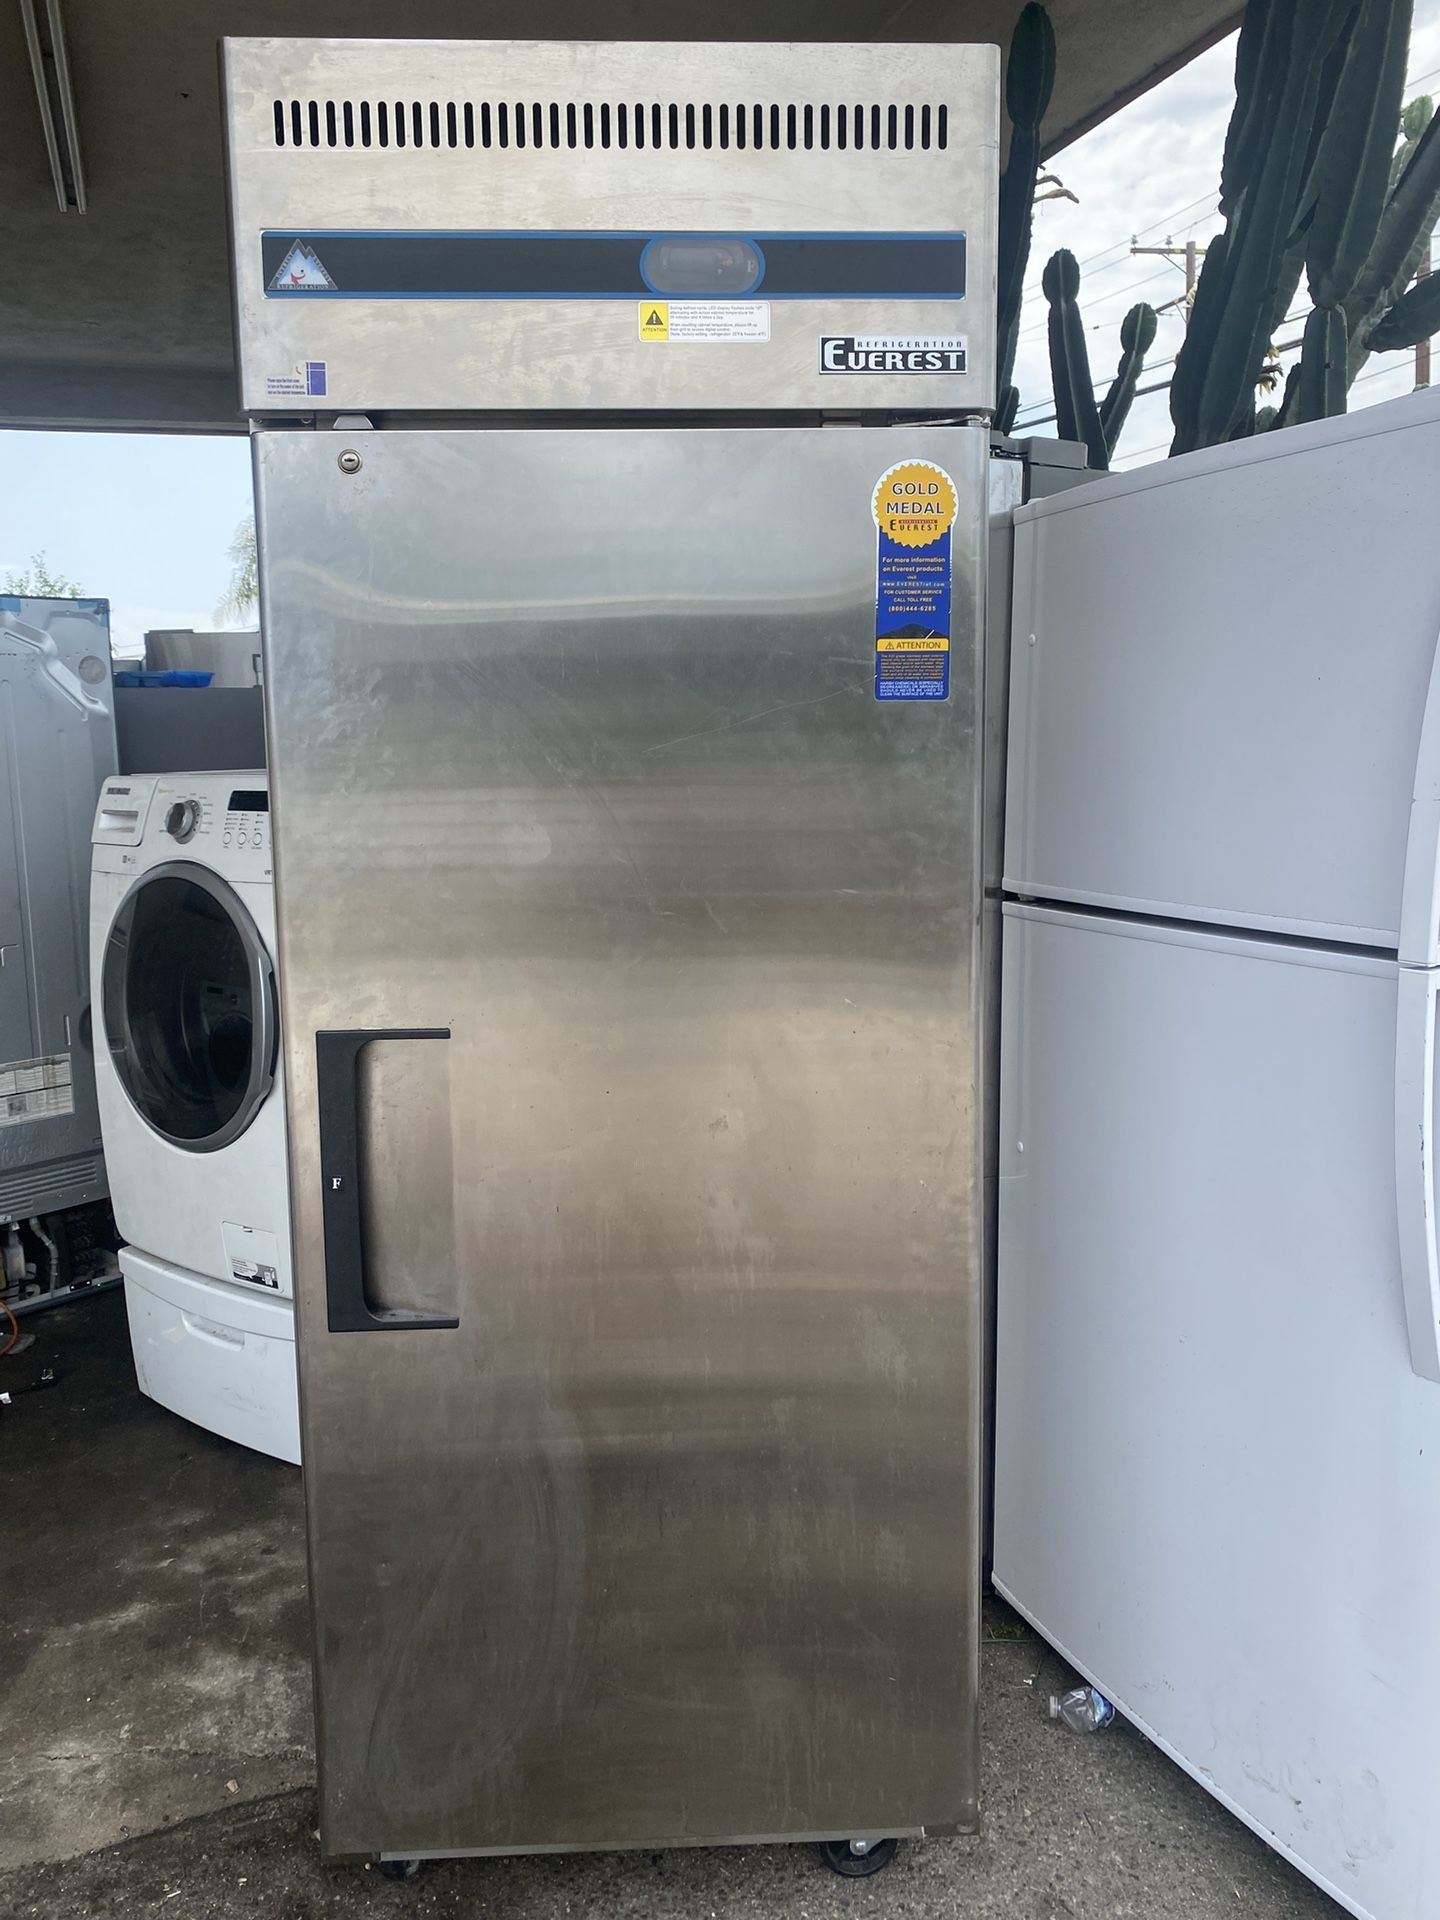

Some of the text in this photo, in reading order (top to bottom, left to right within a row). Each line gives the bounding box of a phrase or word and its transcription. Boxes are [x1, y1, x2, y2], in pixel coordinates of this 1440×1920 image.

[824, 340, 963, 370] EVEREST
[892, 482, 939, 495] GOLD
[886, 502, 944, 514] MEDAL
[890, 519, 938, 531] EVEREST
[896, 641, 941, 650] ATTENTION
[332, 1177, 342, 1189] F
